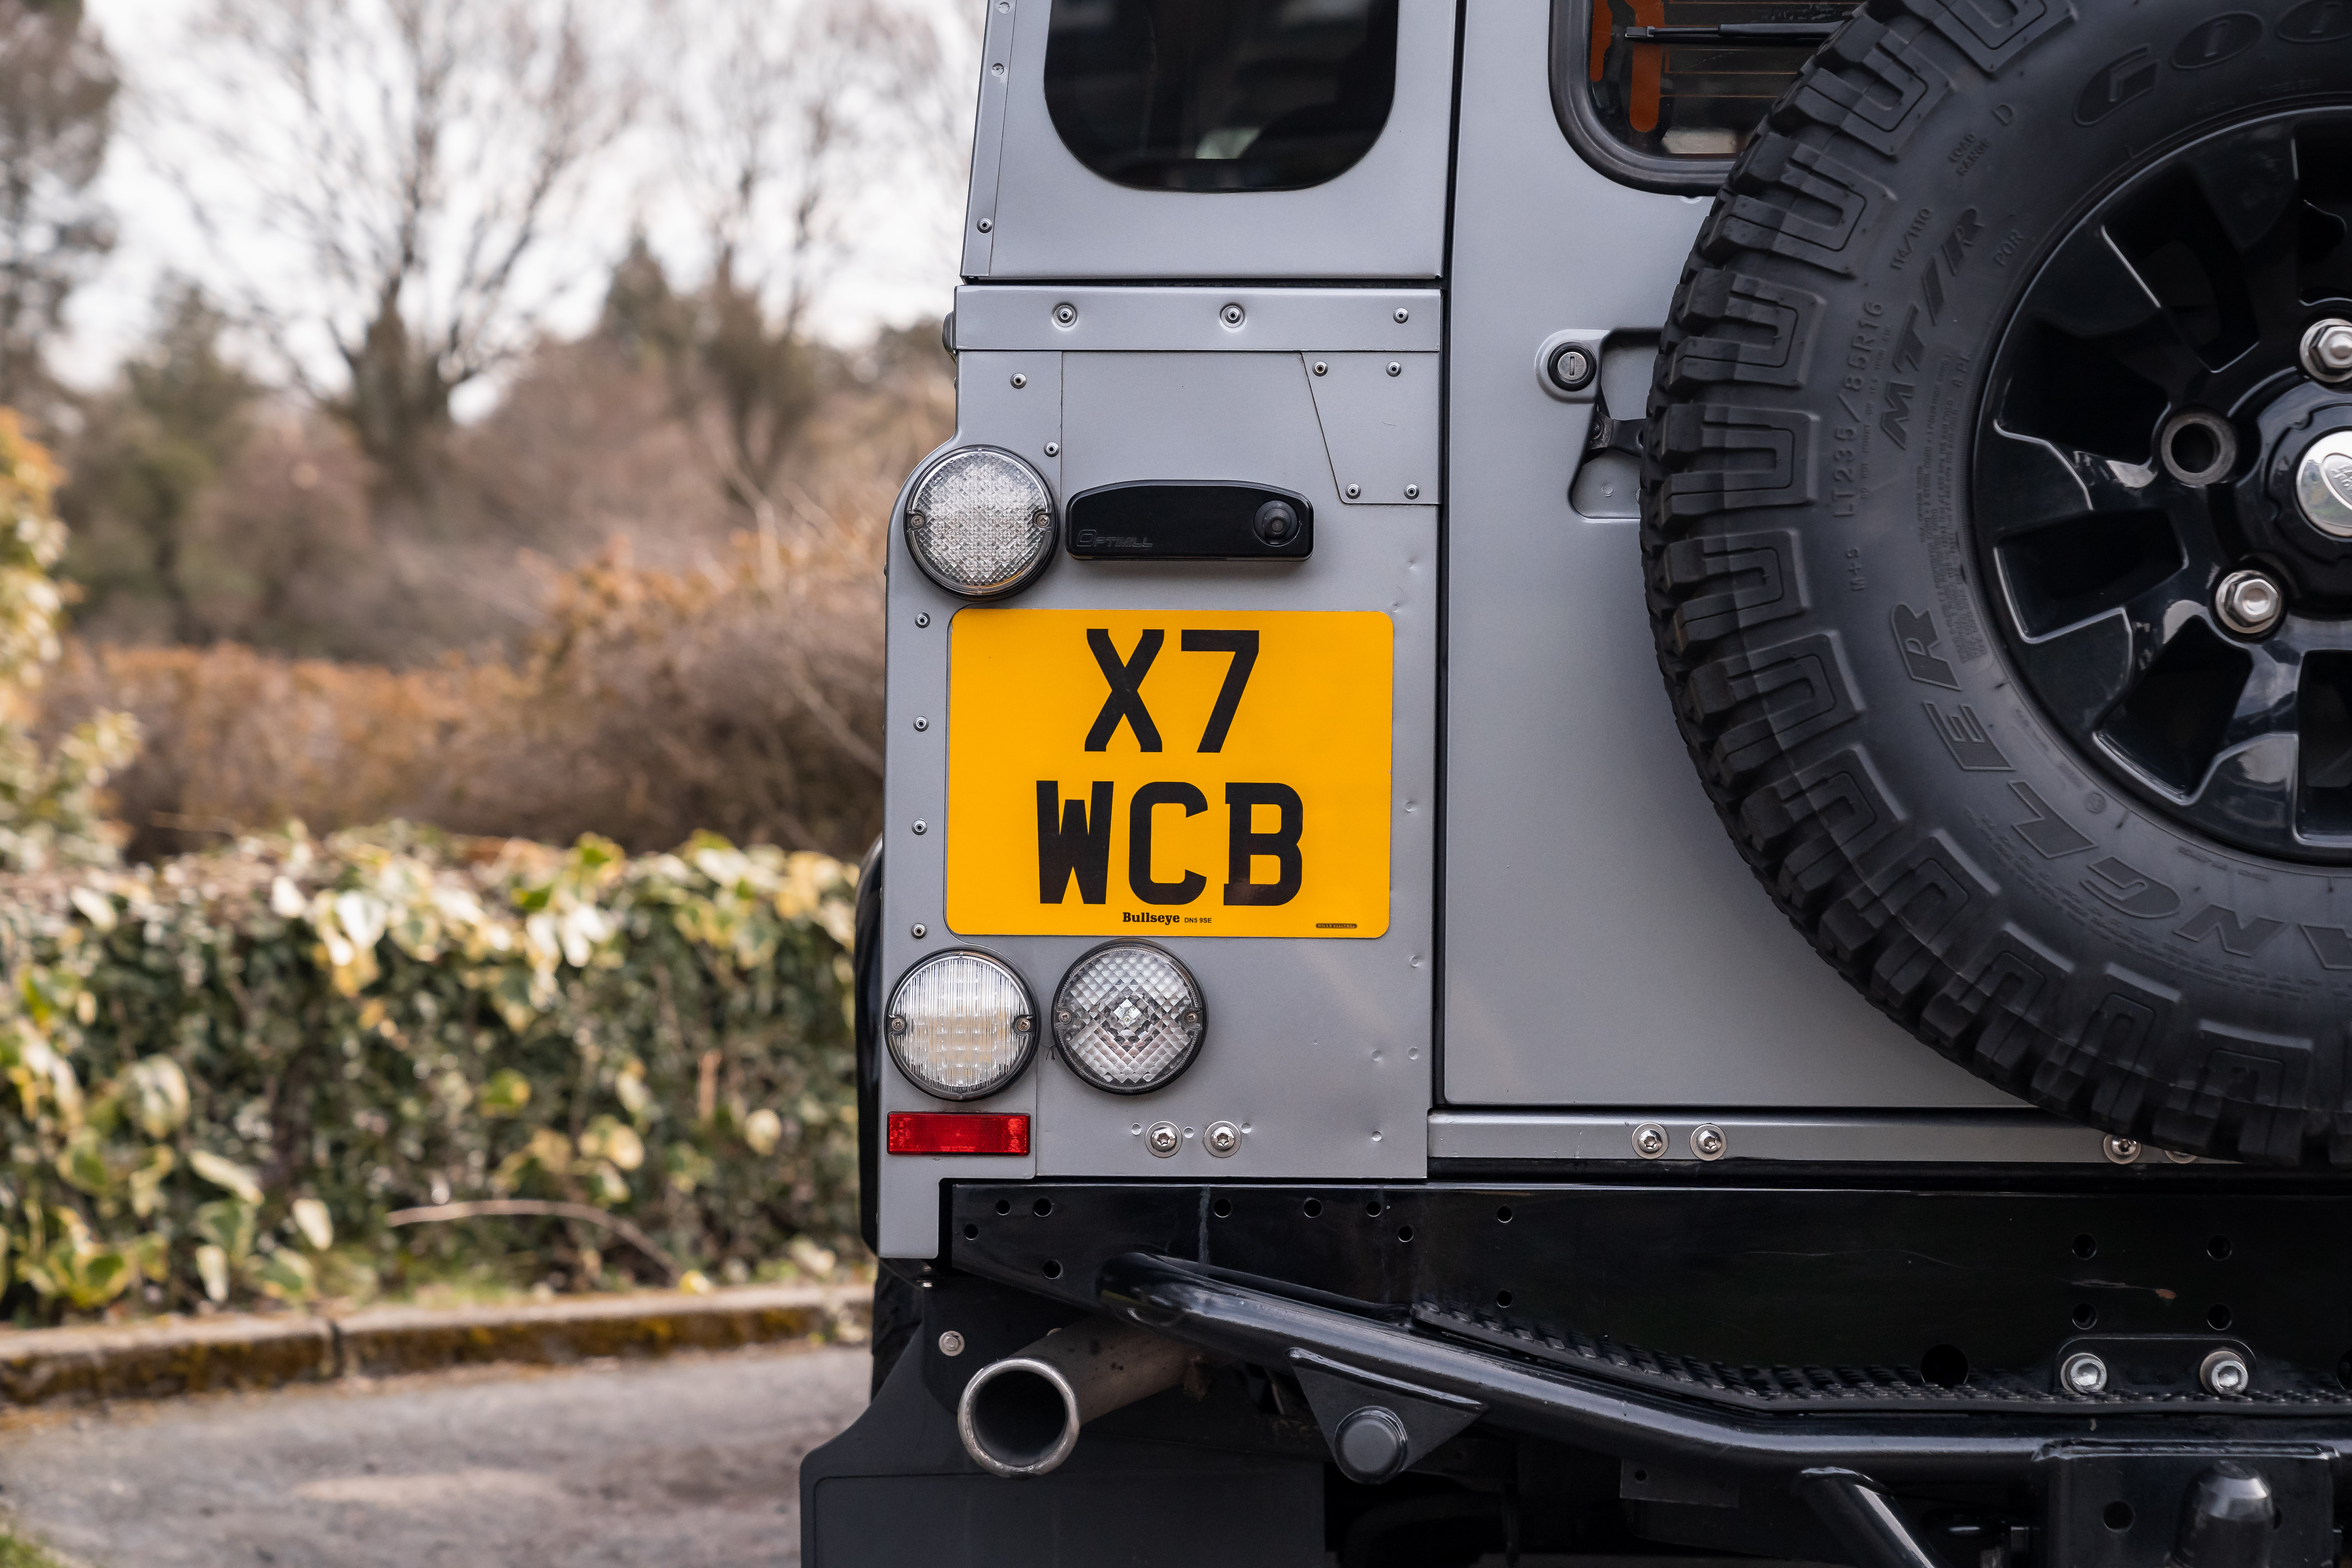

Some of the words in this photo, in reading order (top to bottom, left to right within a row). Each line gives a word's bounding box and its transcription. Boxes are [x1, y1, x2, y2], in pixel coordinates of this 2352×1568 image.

[1084, 628, 1260, 753] X7
[1036, 780, 1303, 906] WCB
[1122, 912, 1180, 926] Bullseye
